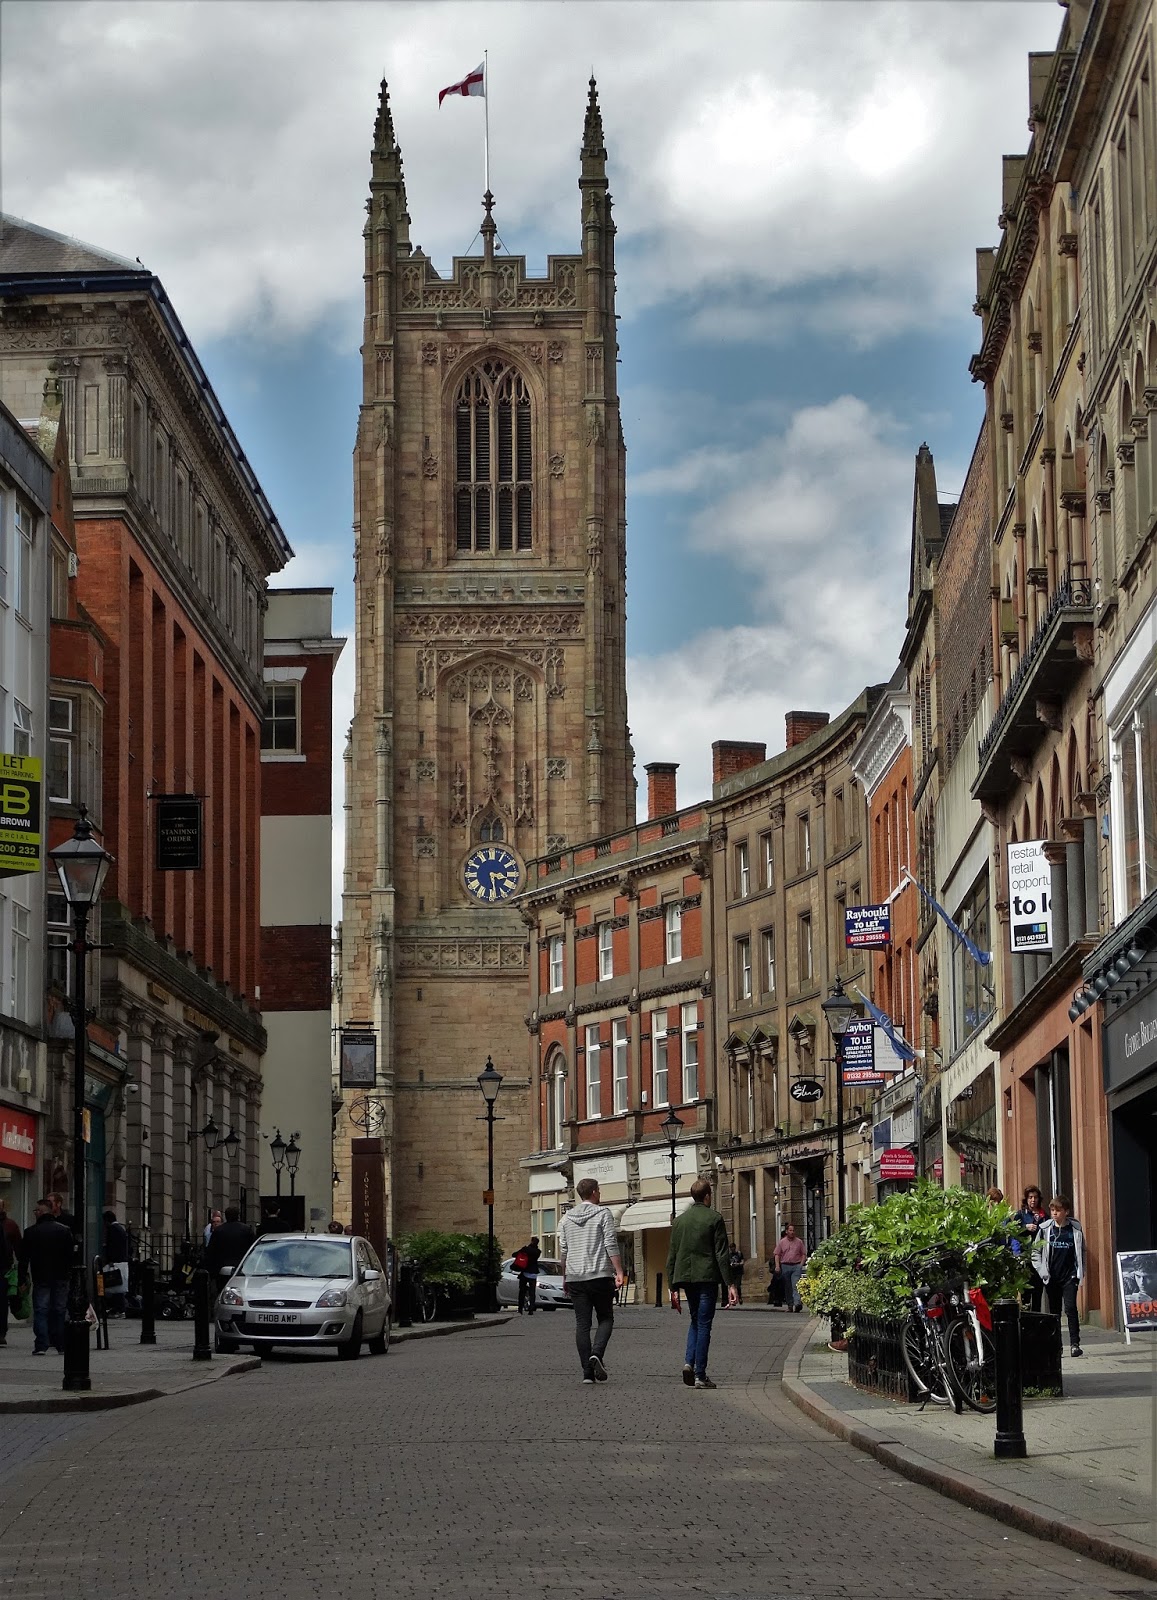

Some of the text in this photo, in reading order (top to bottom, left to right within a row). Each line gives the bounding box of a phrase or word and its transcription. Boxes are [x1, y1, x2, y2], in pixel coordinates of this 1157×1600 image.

[3, 755, 25, 769] LET
[11, 771, 34, 779] PARKING
[0, 817, 30, 827] BROWN
[0, 844, 36, 855] 200 232
[1012, 861, 1034, 874] retail
[1013, 896, 1036, 915] to
[846, 906, 888, 921] Raybould
[258, 1314, 279, 1322] FH08
